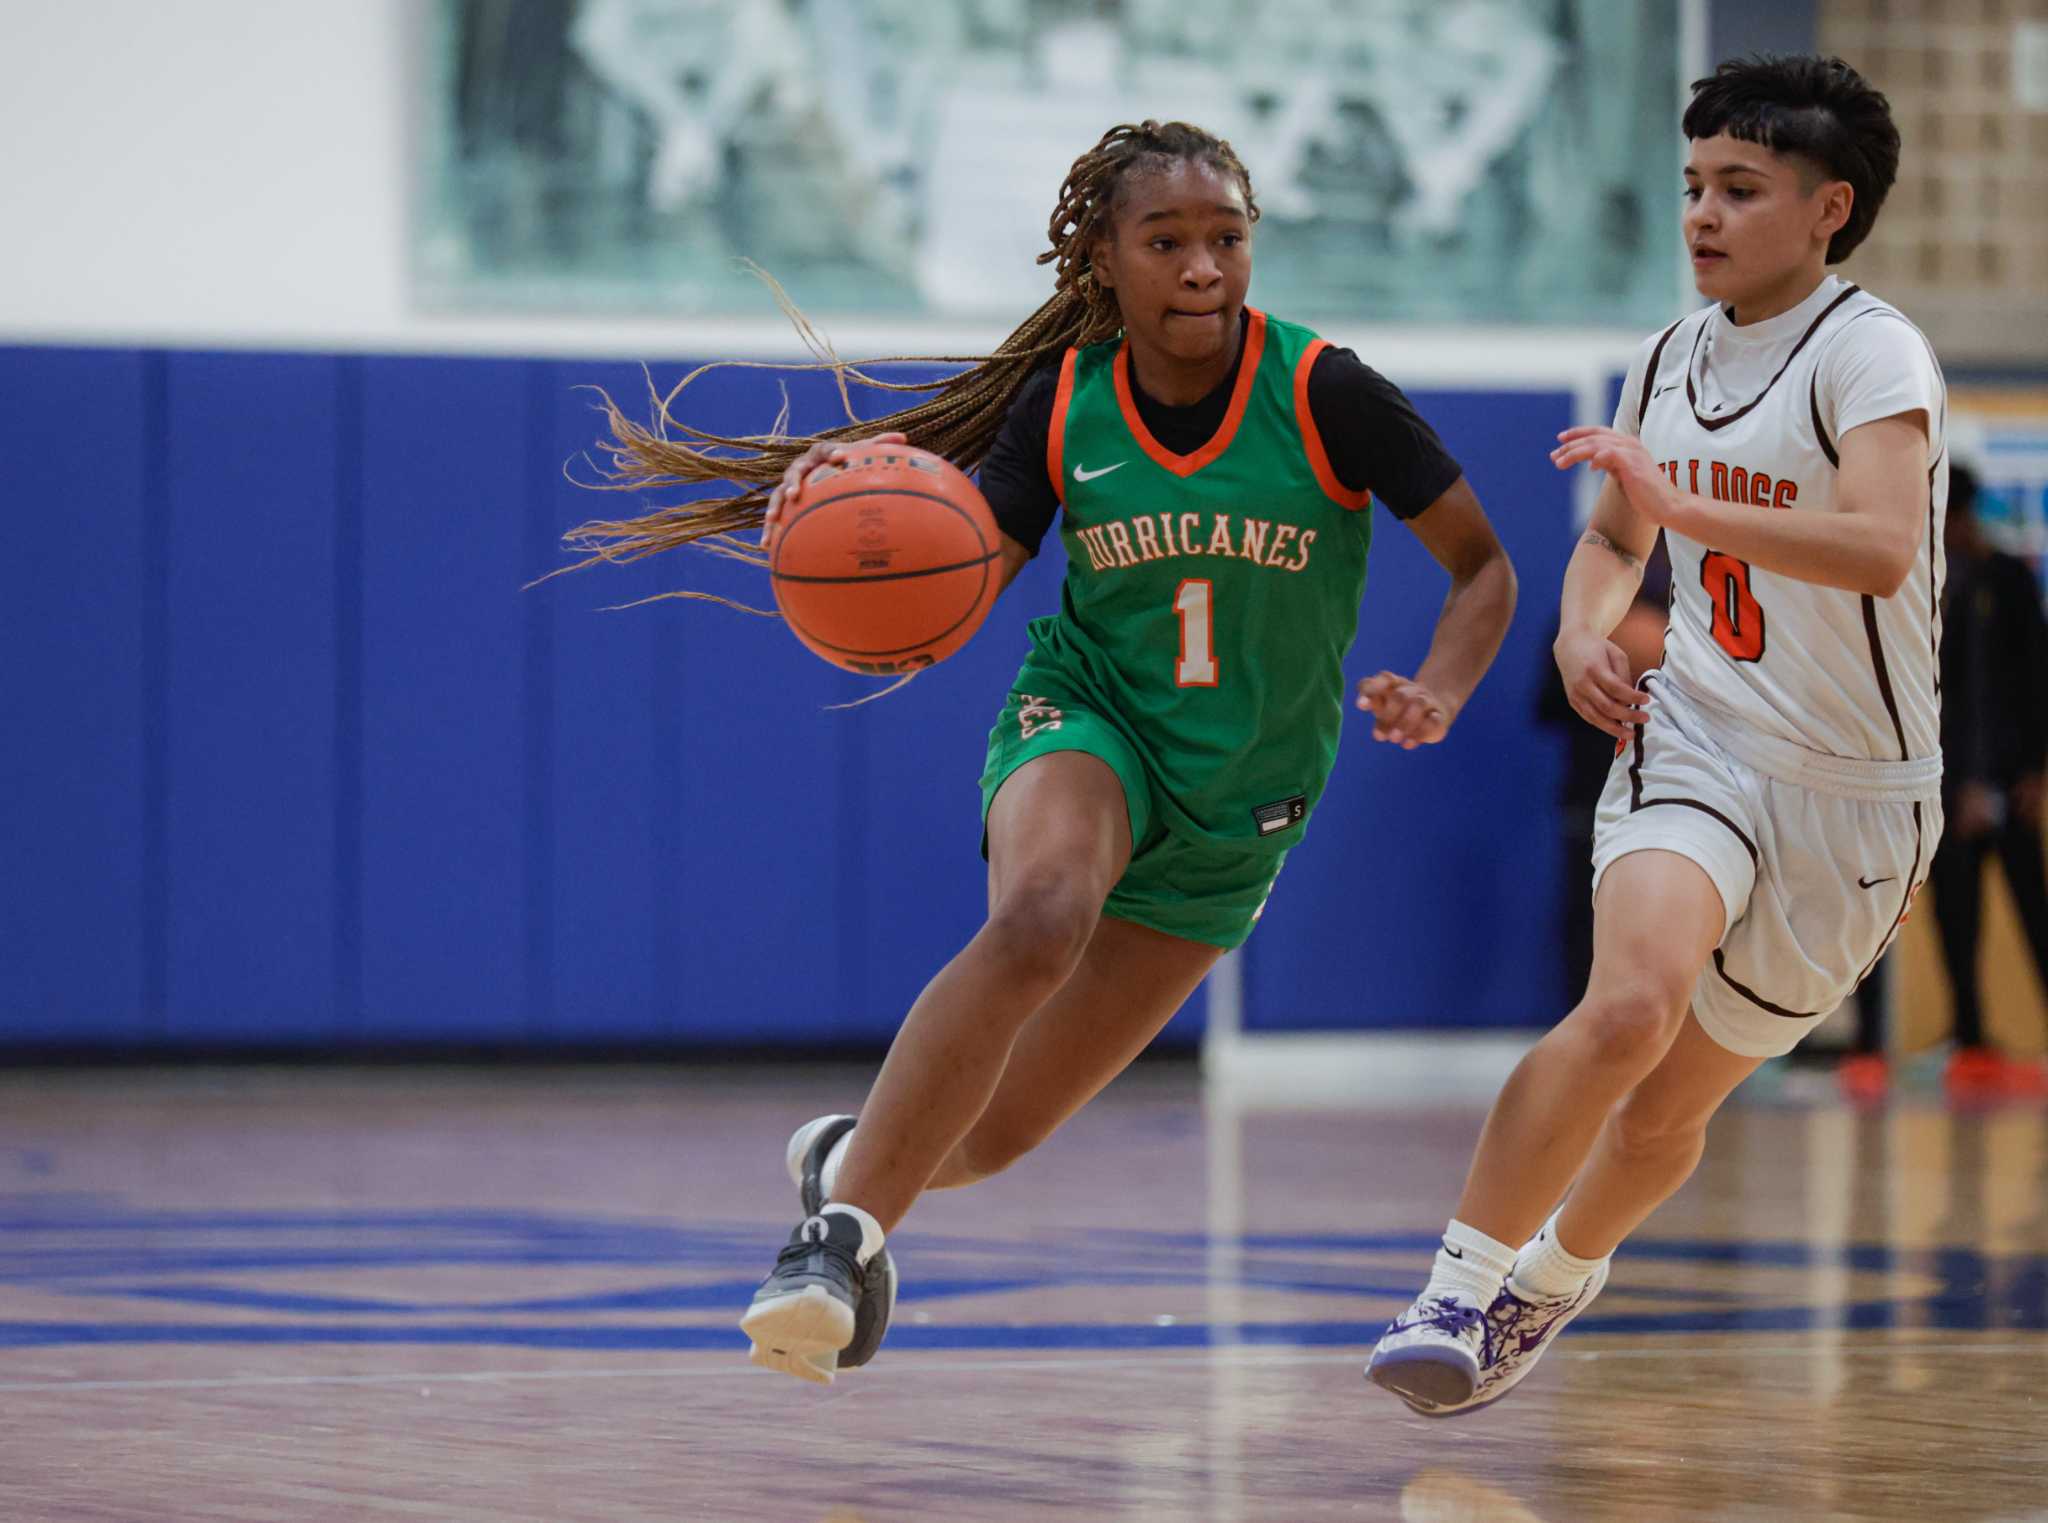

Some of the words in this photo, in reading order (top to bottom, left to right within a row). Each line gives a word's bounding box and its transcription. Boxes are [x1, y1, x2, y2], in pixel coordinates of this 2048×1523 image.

[1657, 459, 1798, 509] LDOGS
[1172, 578, 1219, 688] 1
[1700, 549, 1765, 663] 0
[1293, 804, 1302, 817] S
